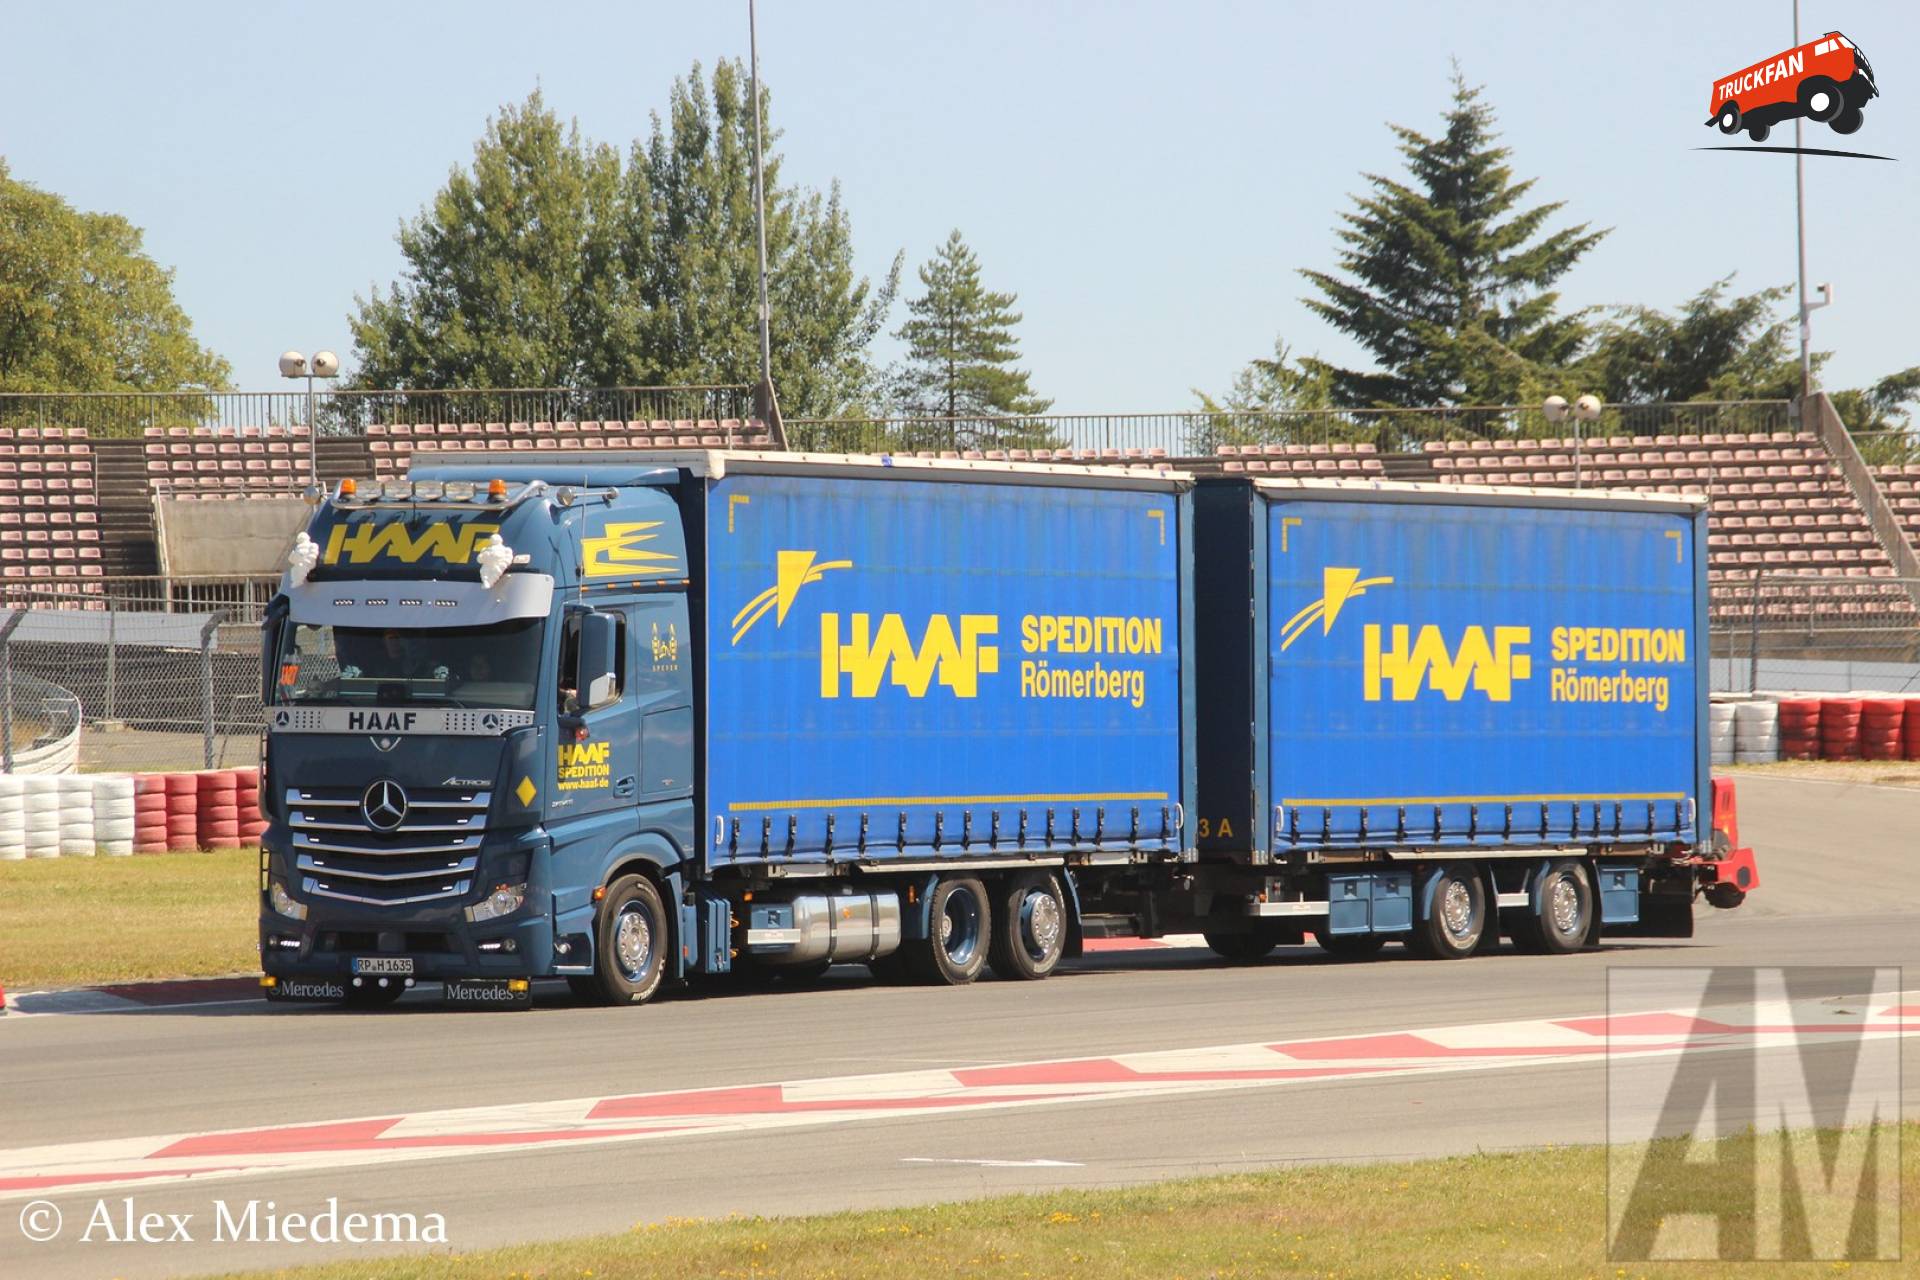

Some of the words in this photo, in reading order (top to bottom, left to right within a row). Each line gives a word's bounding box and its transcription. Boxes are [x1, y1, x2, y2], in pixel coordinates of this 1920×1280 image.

[323, 522, 500, 565] HAAF
[1020, 614, 1162, 655] SPEDITION
[1551, 626, 1686, 664] SPEDITION
[820, 612, 999, 699] HAAF
[1363, 624, 1531, 702] HAAF
[1020, 660, 1146, 710] Römerberg
[1550, 668, 1670, 713] Römerberg
[349, 711, 417, 731] HAAF
[558, 742, 610, 766] HAAF
[558, 763, 610, 779] SPEDITION
[1217, 817, 1234, 839] A
[281, 980, 345, 998] Mercedes
[447, 984, 515, 1001] Mercedes
